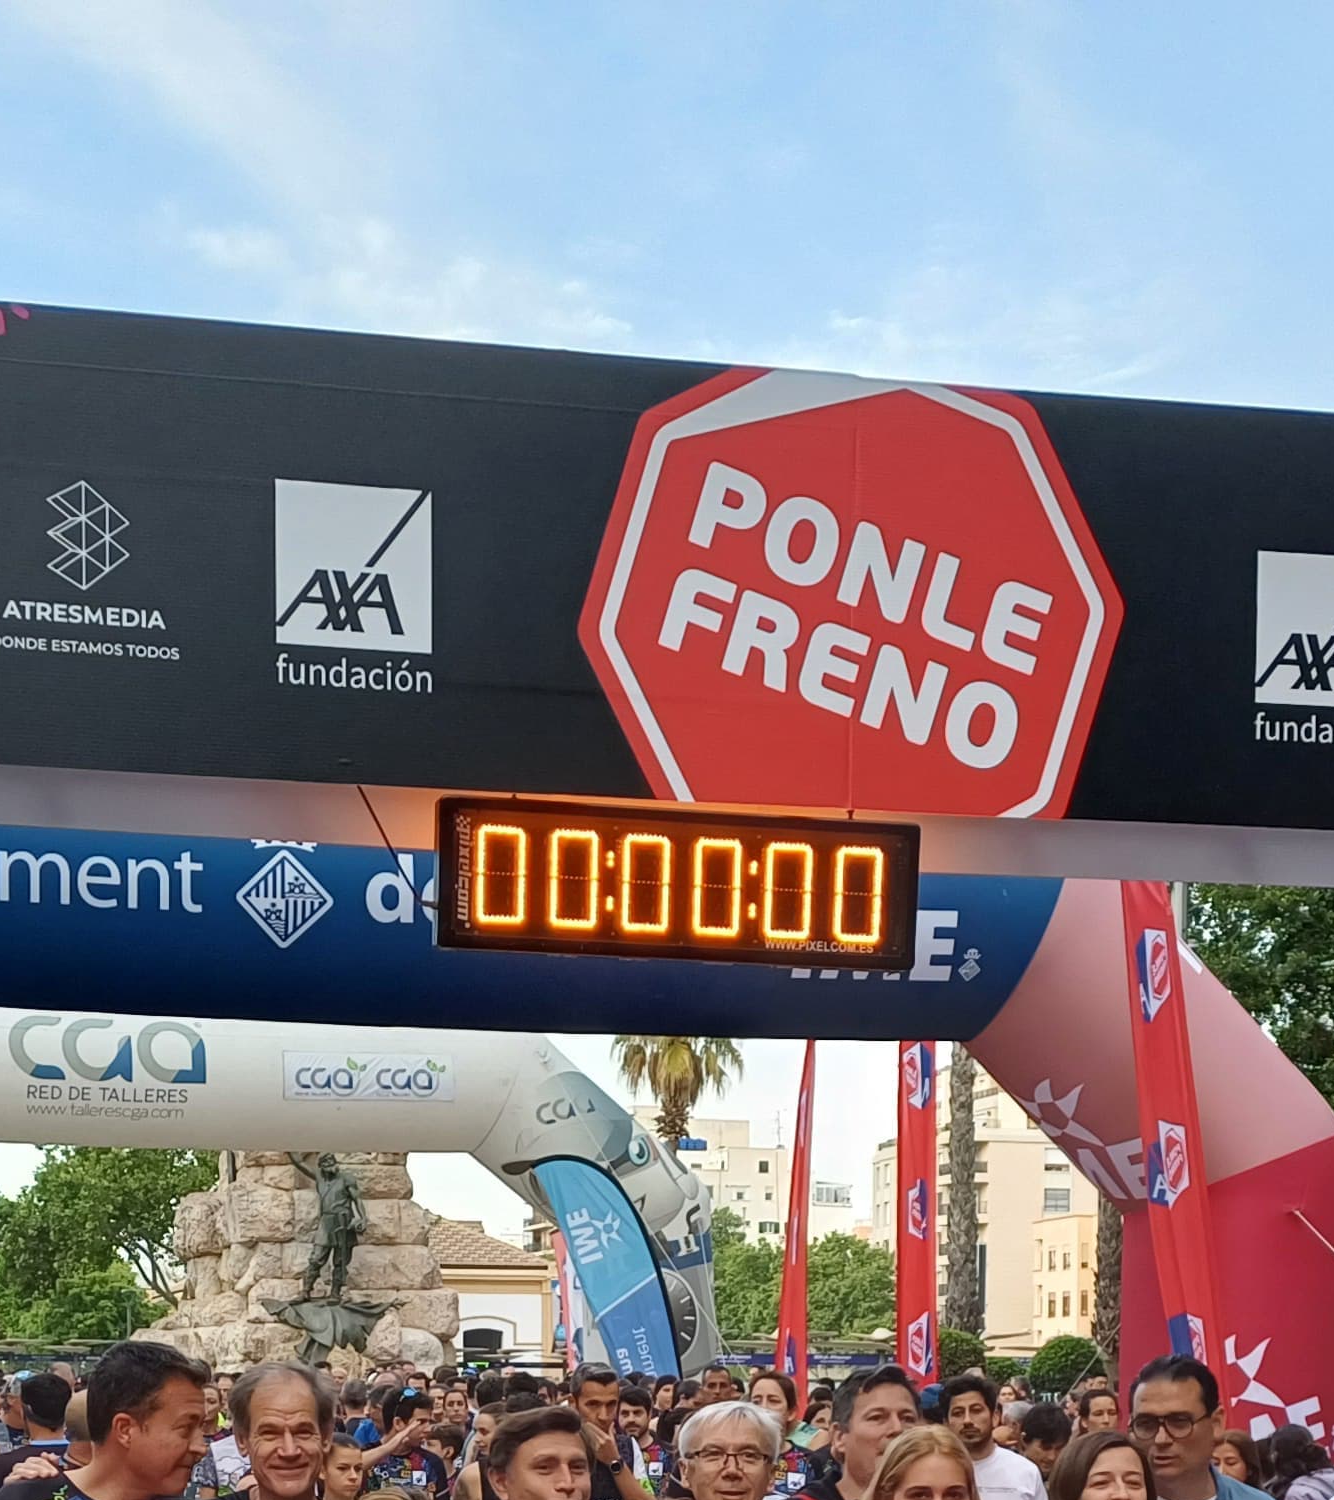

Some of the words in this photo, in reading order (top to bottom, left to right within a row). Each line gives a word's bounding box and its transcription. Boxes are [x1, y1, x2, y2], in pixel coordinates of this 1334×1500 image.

[687, 460, 1054, 676] PONLE
[1, 600, 166, 631] ATRESMEDIA
[275, 569, 405, 637] AXA
[50, 637, 123, 657] ESTAMOS
[125, 641, 180, 661] TODOS
[275, 654, 434, 695] fundación
[657, 568, 1019, 770] FRENO
[365, 853, 435, 926] d
[475, 822, 884, 944] 00:00:00
[764, 937, 874, 954] WWW.PIXELCOM.ES
[27, 1085, 63, 1100] RED
[69, 1086, 93, 1102] DE
[99, 1086, 188, 1104] TALLERES
